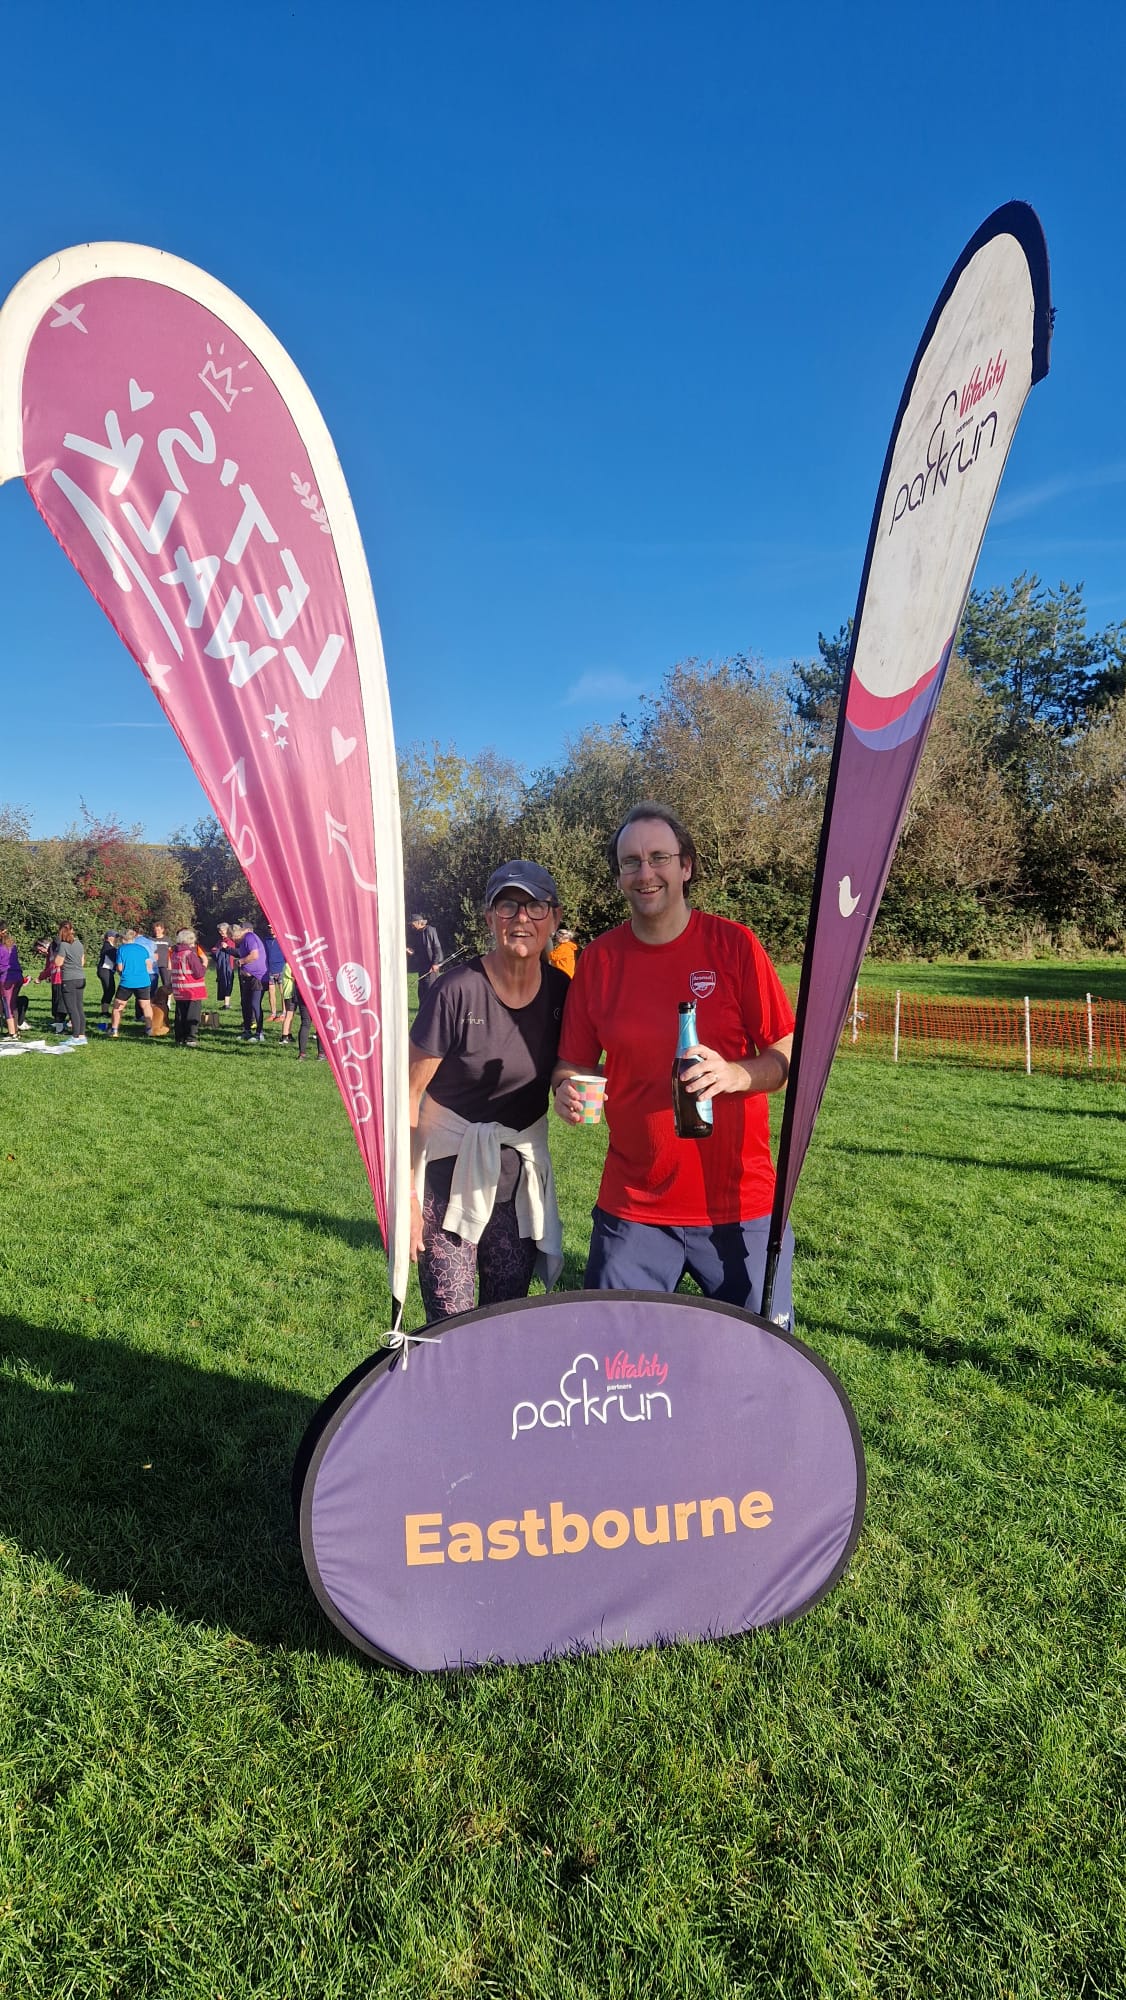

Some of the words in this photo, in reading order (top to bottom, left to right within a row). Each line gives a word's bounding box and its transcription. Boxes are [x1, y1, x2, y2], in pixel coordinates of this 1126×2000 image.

[960, 349, 1008, 418] Vitality
[889, 410, 998, 537] parkrun
[605, 1350, 669, 1386] Vitality
[606, 1383, 632, 1393] partners
[511, 1378, 672, 1441] parkrun
[405, 1490, 774, 1567] Eastbourne
